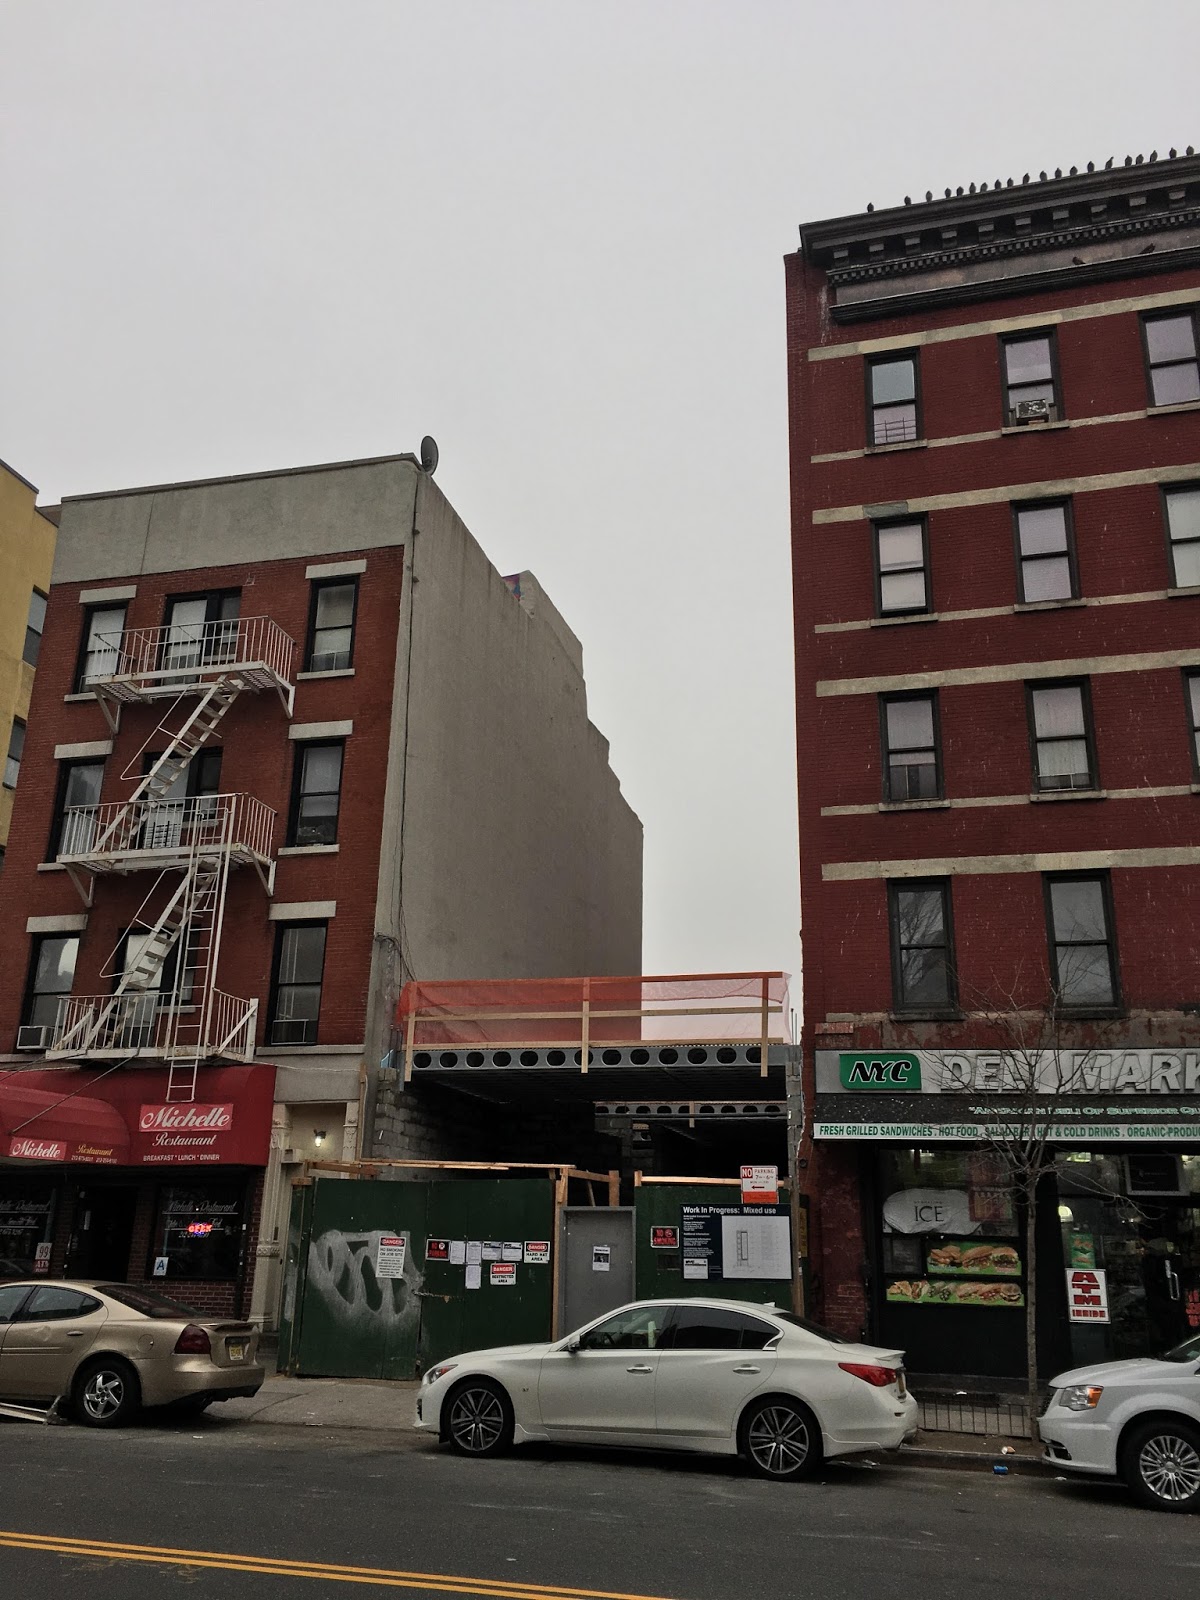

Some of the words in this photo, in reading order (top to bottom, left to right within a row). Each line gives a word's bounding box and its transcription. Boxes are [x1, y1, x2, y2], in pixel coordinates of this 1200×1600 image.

[849, 1060, 912, 1083] NYC
[941, 1054, 1041, 1091] DELI
[141, 1106, 230, 1129] Michelle
[152, 1131, 217, 1147] Restaurant
[819, 1125, 845, 1136] FRESH
[846, 1125, 878, 1136] GRILLED
[880, 1125, 932, 1137] SANDWICHES
[938, 1126, 955, 1137] HOT
[956, 1126, 978, 1137] FOOD
[1055, 1127, 1062, 1137] &
[1063, 1126, 1086, 1137] COLD
[1088, 1126, 1120, 1137] DRINKS
[1127, 1126, 1166, 1137] ORGANIC
[12, 1139, 61, 1158] Michelle
[143, 1154, 174, 1162] BREAKFAST
[200, 1153, 220, 1161] DINNER
[742, 1168, 753, 1178] NO
[683, 1206, 700, 1214] Work
[701, 1206, 708, 1214] In
[708, 1206, 741, 1215] Progress:
[743, 1206, 763, 1214] Mixed
[914, 1205, 945, 1223] ICE
[156, 1260, 165, 1271] A
[1071, 1271, 1103, 1306] ATM
[1072, 1309, 1107, 1318] INSIDE
